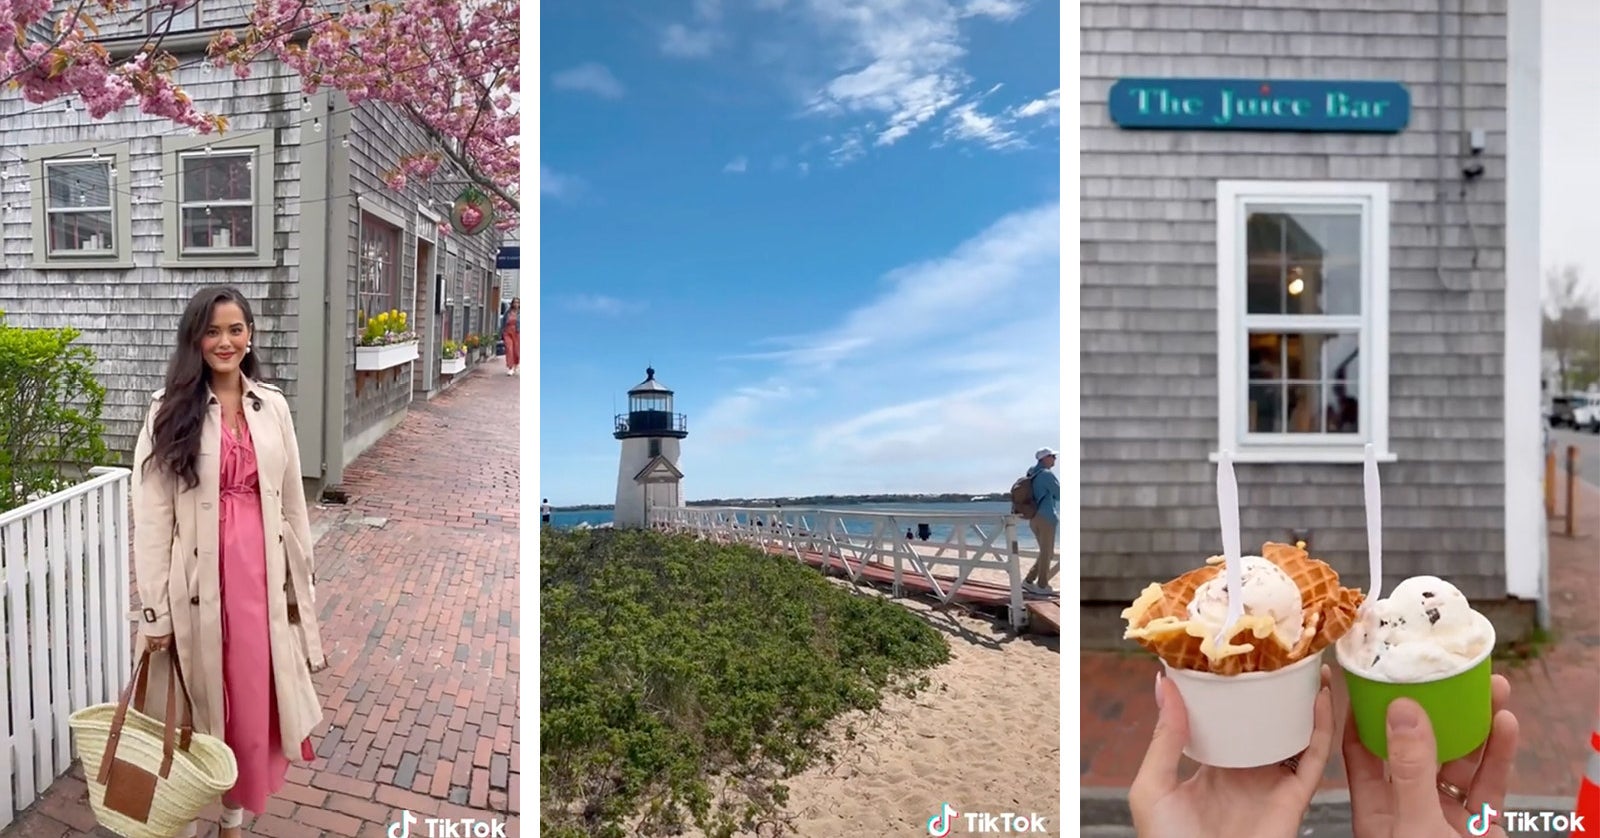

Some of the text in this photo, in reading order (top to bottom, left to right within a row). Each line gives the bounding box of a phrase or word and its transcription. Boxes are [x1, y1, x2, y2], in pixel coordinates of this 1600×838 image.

[1129, 85, 1390, 125] The Juice Bar
